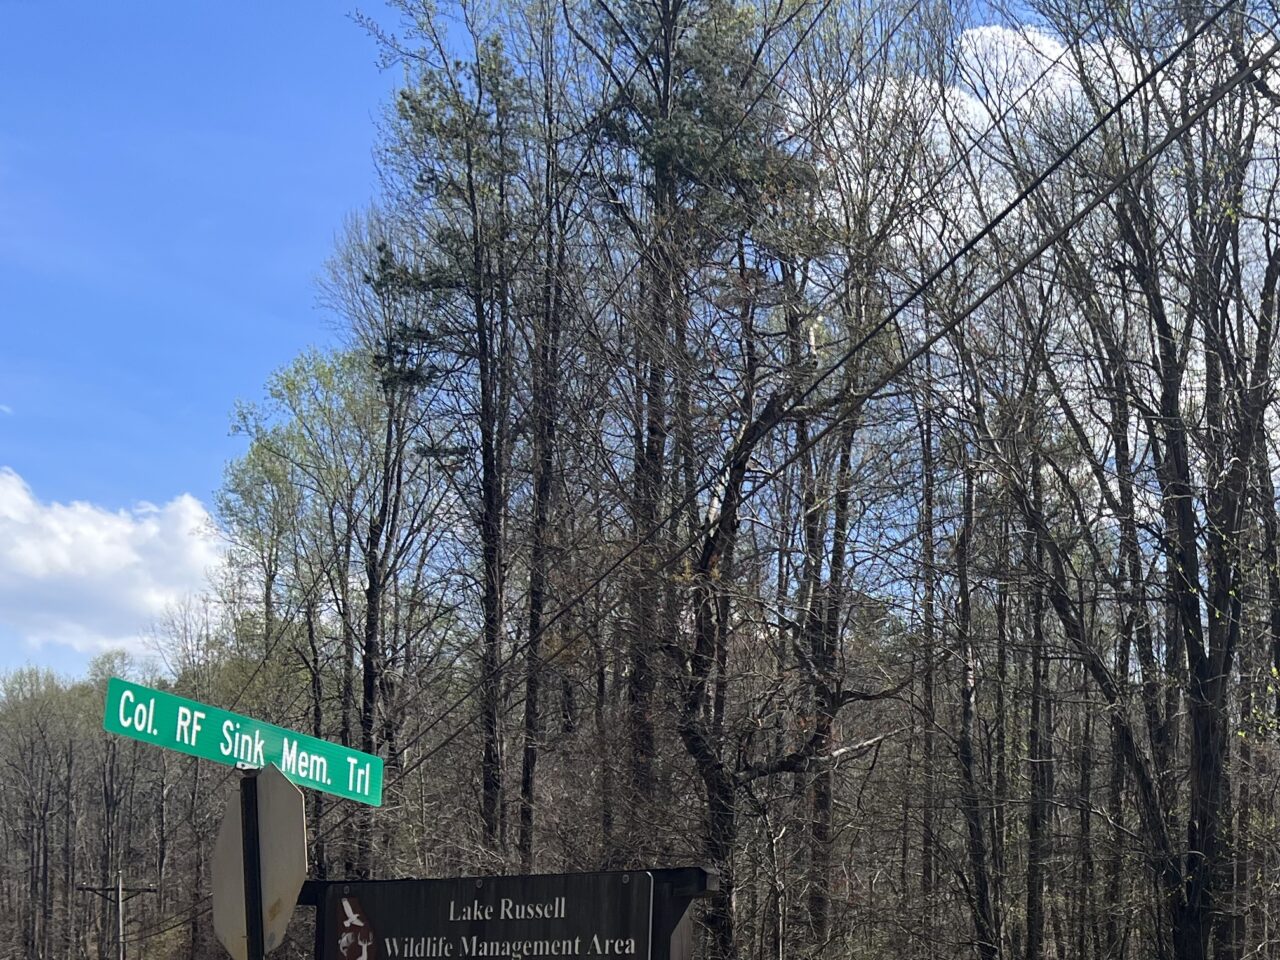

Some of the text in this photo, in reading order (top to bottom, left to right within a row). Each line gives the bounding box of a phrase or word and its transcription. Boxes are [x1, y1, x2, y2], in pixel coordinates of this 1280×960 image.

[118, 690, 371, 796] Col. RF Sink Mem. Trl
[449, 896, 566, 922] Lake Russell
[384, 933, 636, 960] Wildlife Management Area
